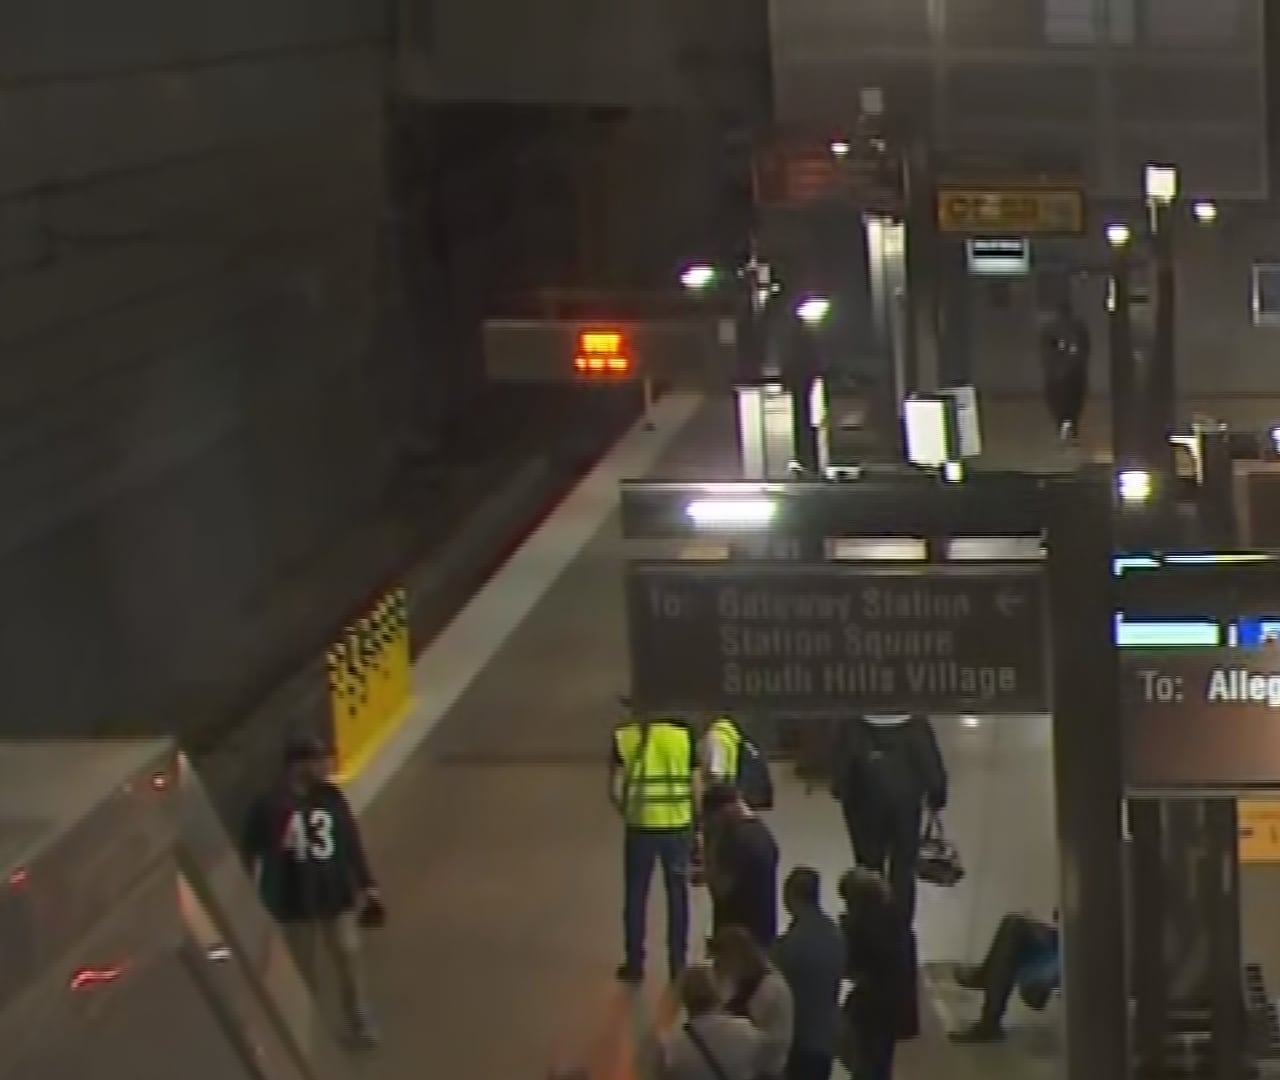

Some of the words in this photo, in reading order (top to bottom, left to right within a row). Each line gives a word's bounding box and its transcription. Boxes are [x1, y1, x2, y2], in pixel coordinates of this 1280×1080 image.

[718, 587, 850, 622] Gateway
[862, 587, 970, 618] Station
[720, 625, 830, 656] Station
[843, 624, 953, 660] Square
[722, 662, 811, 694] South
[823, 662, 895, 694] Hills
[906, 662, 1017, 699] Village
[1140, 671, 1183, 701] To:
